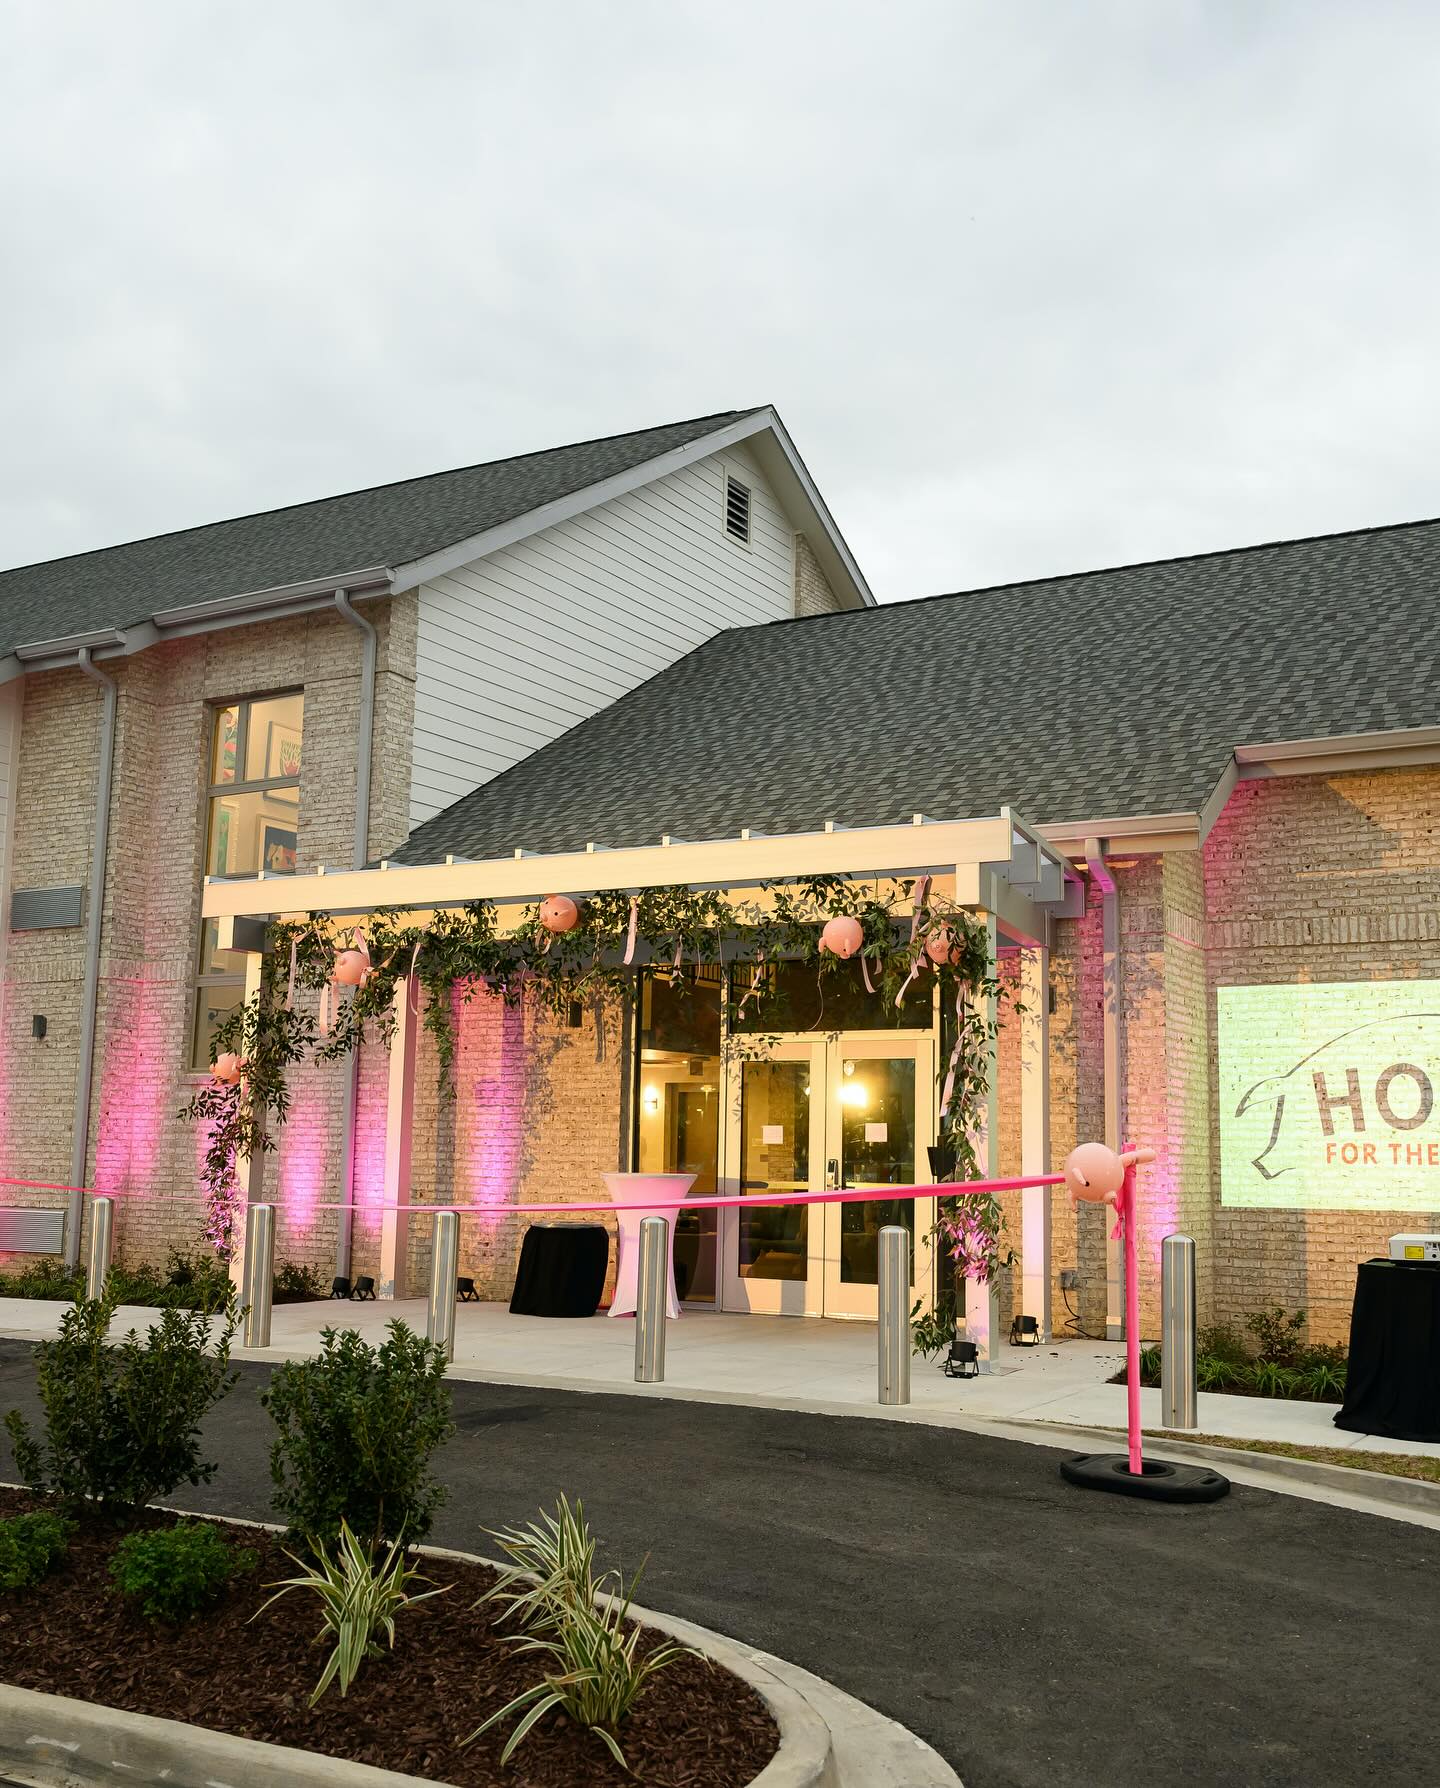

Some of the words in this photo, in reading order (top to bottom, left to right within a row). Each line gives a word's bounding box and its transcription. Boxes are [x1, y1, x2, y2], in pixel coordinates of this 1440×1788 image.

[1312, 1062, 1434, 1136] HO
[1326, 1143, 1377, 1164] FOR
[1388, 1143, 1440, 1166] THE
